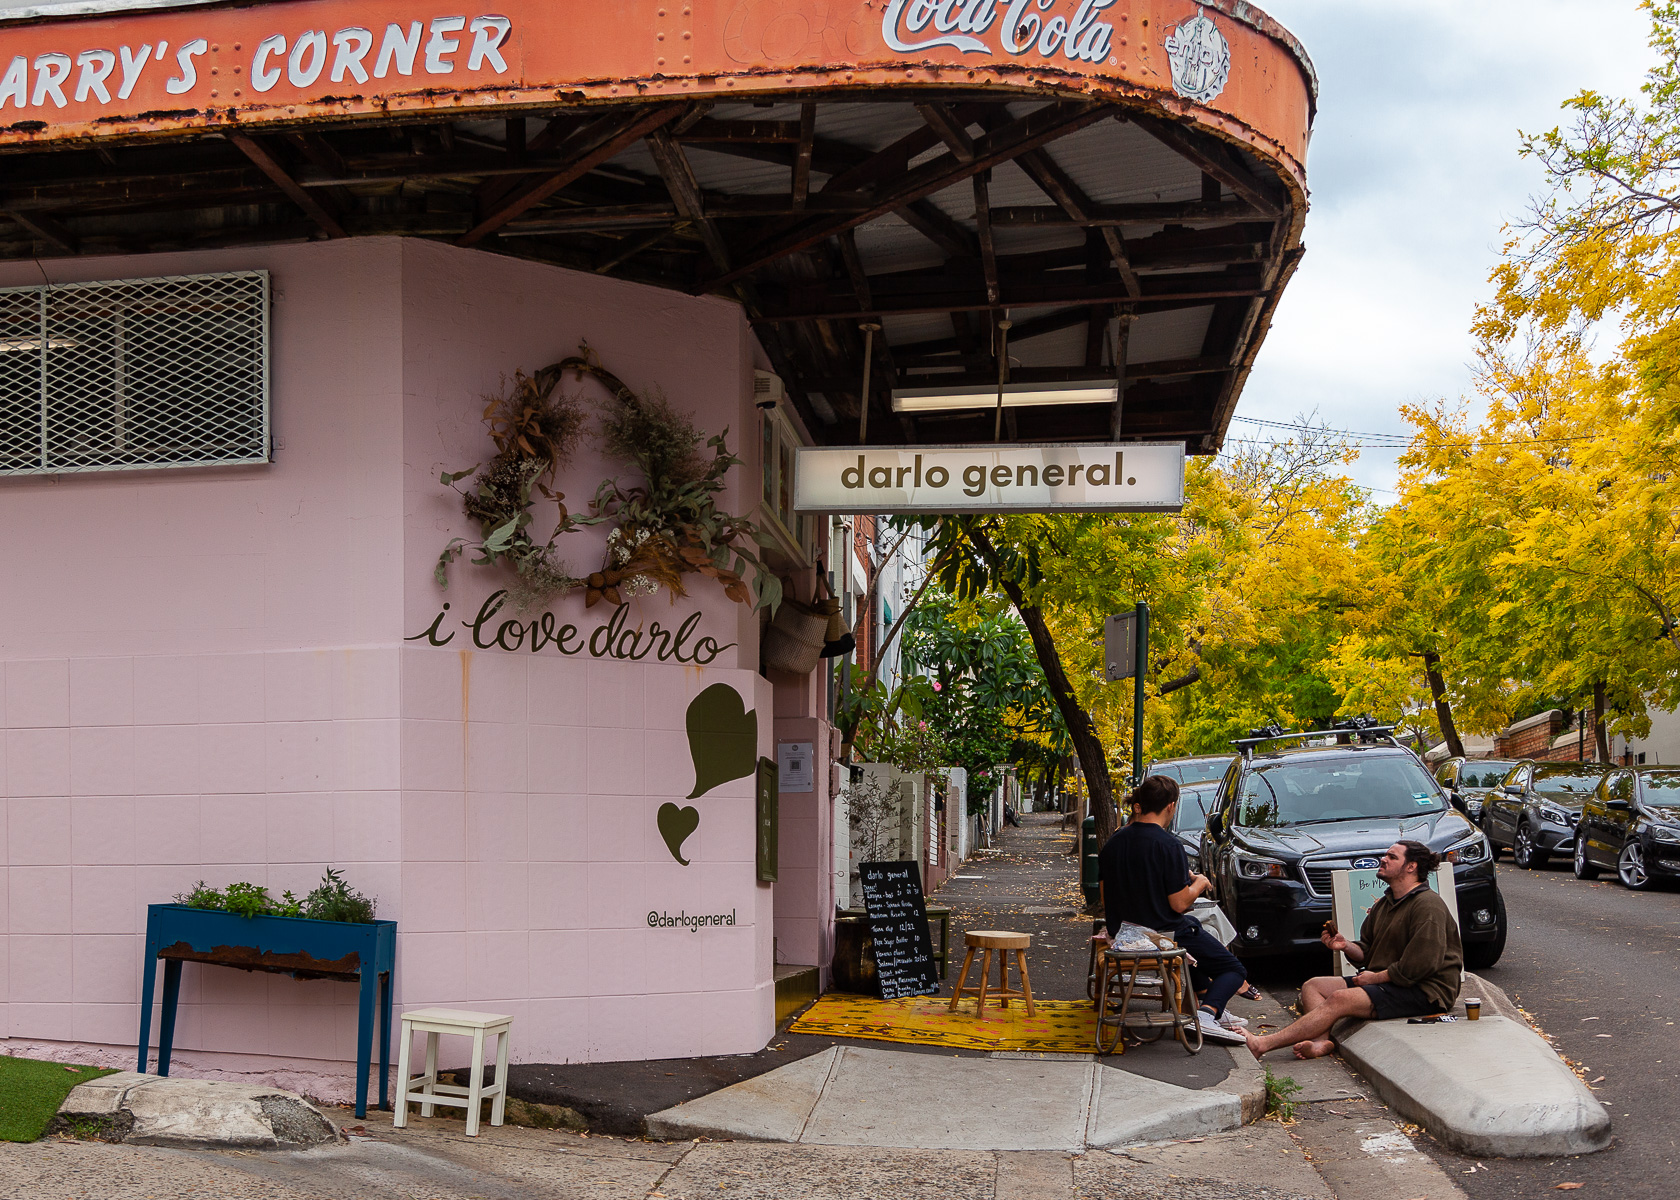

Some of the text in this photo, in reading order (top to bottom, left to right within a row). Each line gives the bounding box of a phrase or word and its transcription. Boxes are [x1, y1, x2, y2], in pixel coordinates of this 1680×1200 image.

[251, 14, 512, 93] CORNER
[840, 451, 1137, 497] darlo general.
[403, 589, 738, 665] i love darlo
[867, 868, 909, 881] darlo general
[1359, 879, 1370, 890] Be
[647, 908, 736, 933] @darlogeneral
[913, 909, 920, 917] 12
